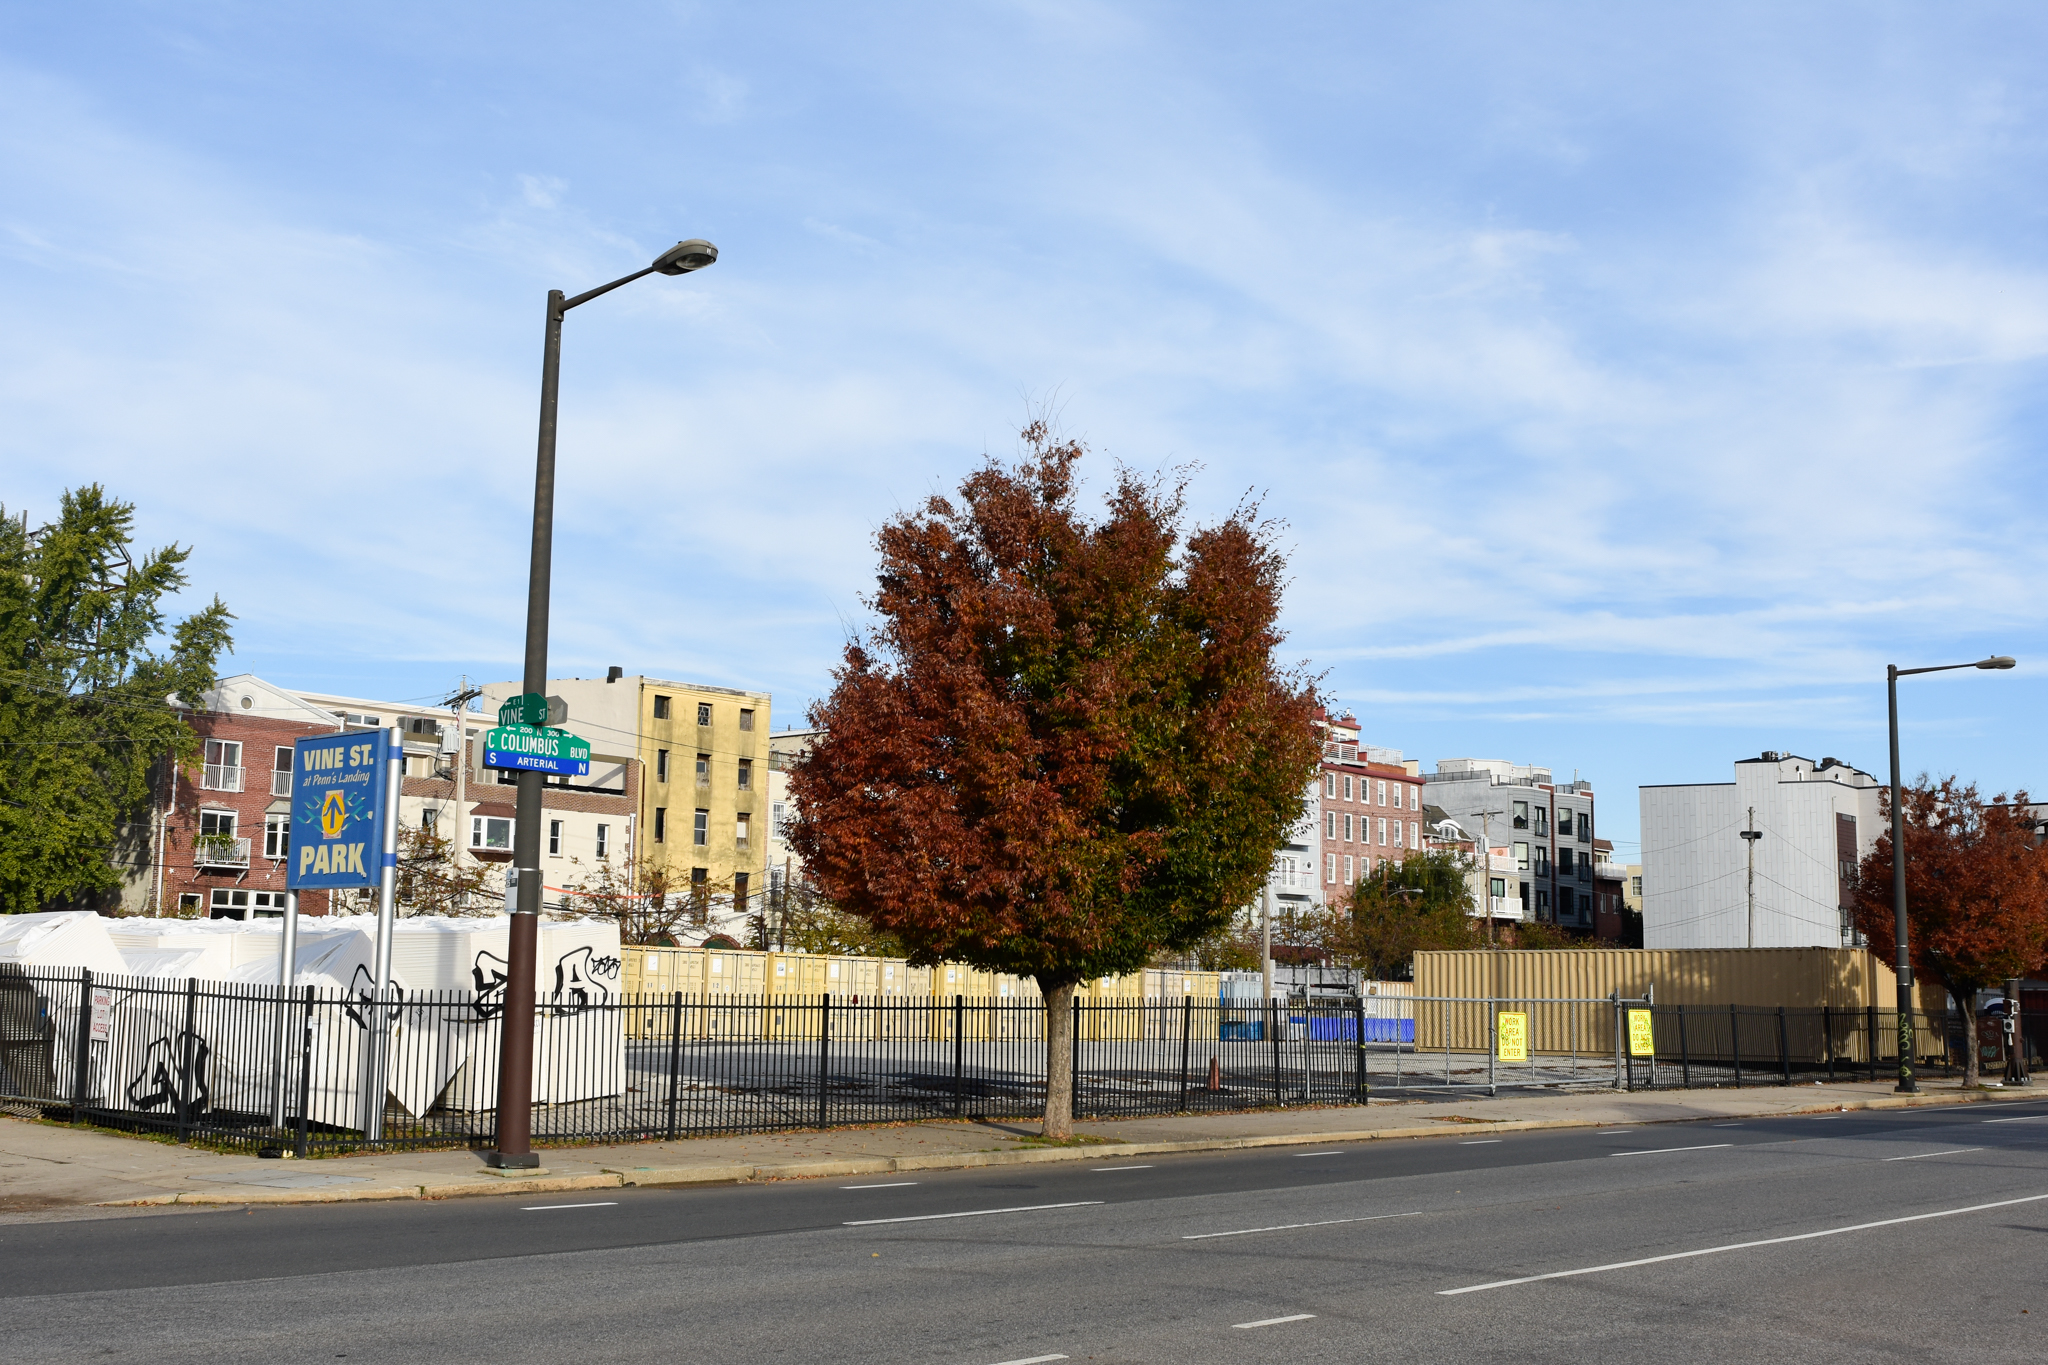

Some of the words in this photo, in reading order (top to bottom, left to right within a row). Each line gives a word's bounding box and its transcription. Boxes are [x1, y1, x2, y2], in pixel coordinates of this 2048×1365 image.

[500, 707, 524, 725] VINE
[538, 708, 546, 720] ST
[520, 726, 533, 734] 200
[536, 728, 542, 736] N
[547, 730, 560, 738] 300
[488, 732, 495, 748] C
[501, 733, 559, 756] COLUMBUS
[570, 747, 588, 760] BLVD
[303, 747, 345, 771] VINE
[349, 744, 374, 767] ST.
[489, 752, 497, 764] S
[517, 757, 559, 770] ARTERIAL
[578, 763, 586, 774] N
[303, 774, 311, 786] at
[312, 771, 336, 786] Penn's
[338, 769, 370, 786] Landing
[300, 843, 366, 876] PARK
[95, 995, 110, 1006] PARKING
[97, 1009, 105, 1019] LOT
[1634, 1014, 1646, 1022] WORK
[1505, 1017, 1520, 1026] WORK
[93, 1022, 107, 1033] ACCESS
[1505, 1027, 1519, 1036] AREA
[1635, 1024, 1646, 1032] AREA
[1502, 1038, 1509, 1046] DO
[1512, 1038, 1523, 1046] NOT
[1632, 1033, 1639, 1041] DO
[1635, 1043, 1649, 1051] ENTER
[1504, 1048, 1520, 1057] ENTER
